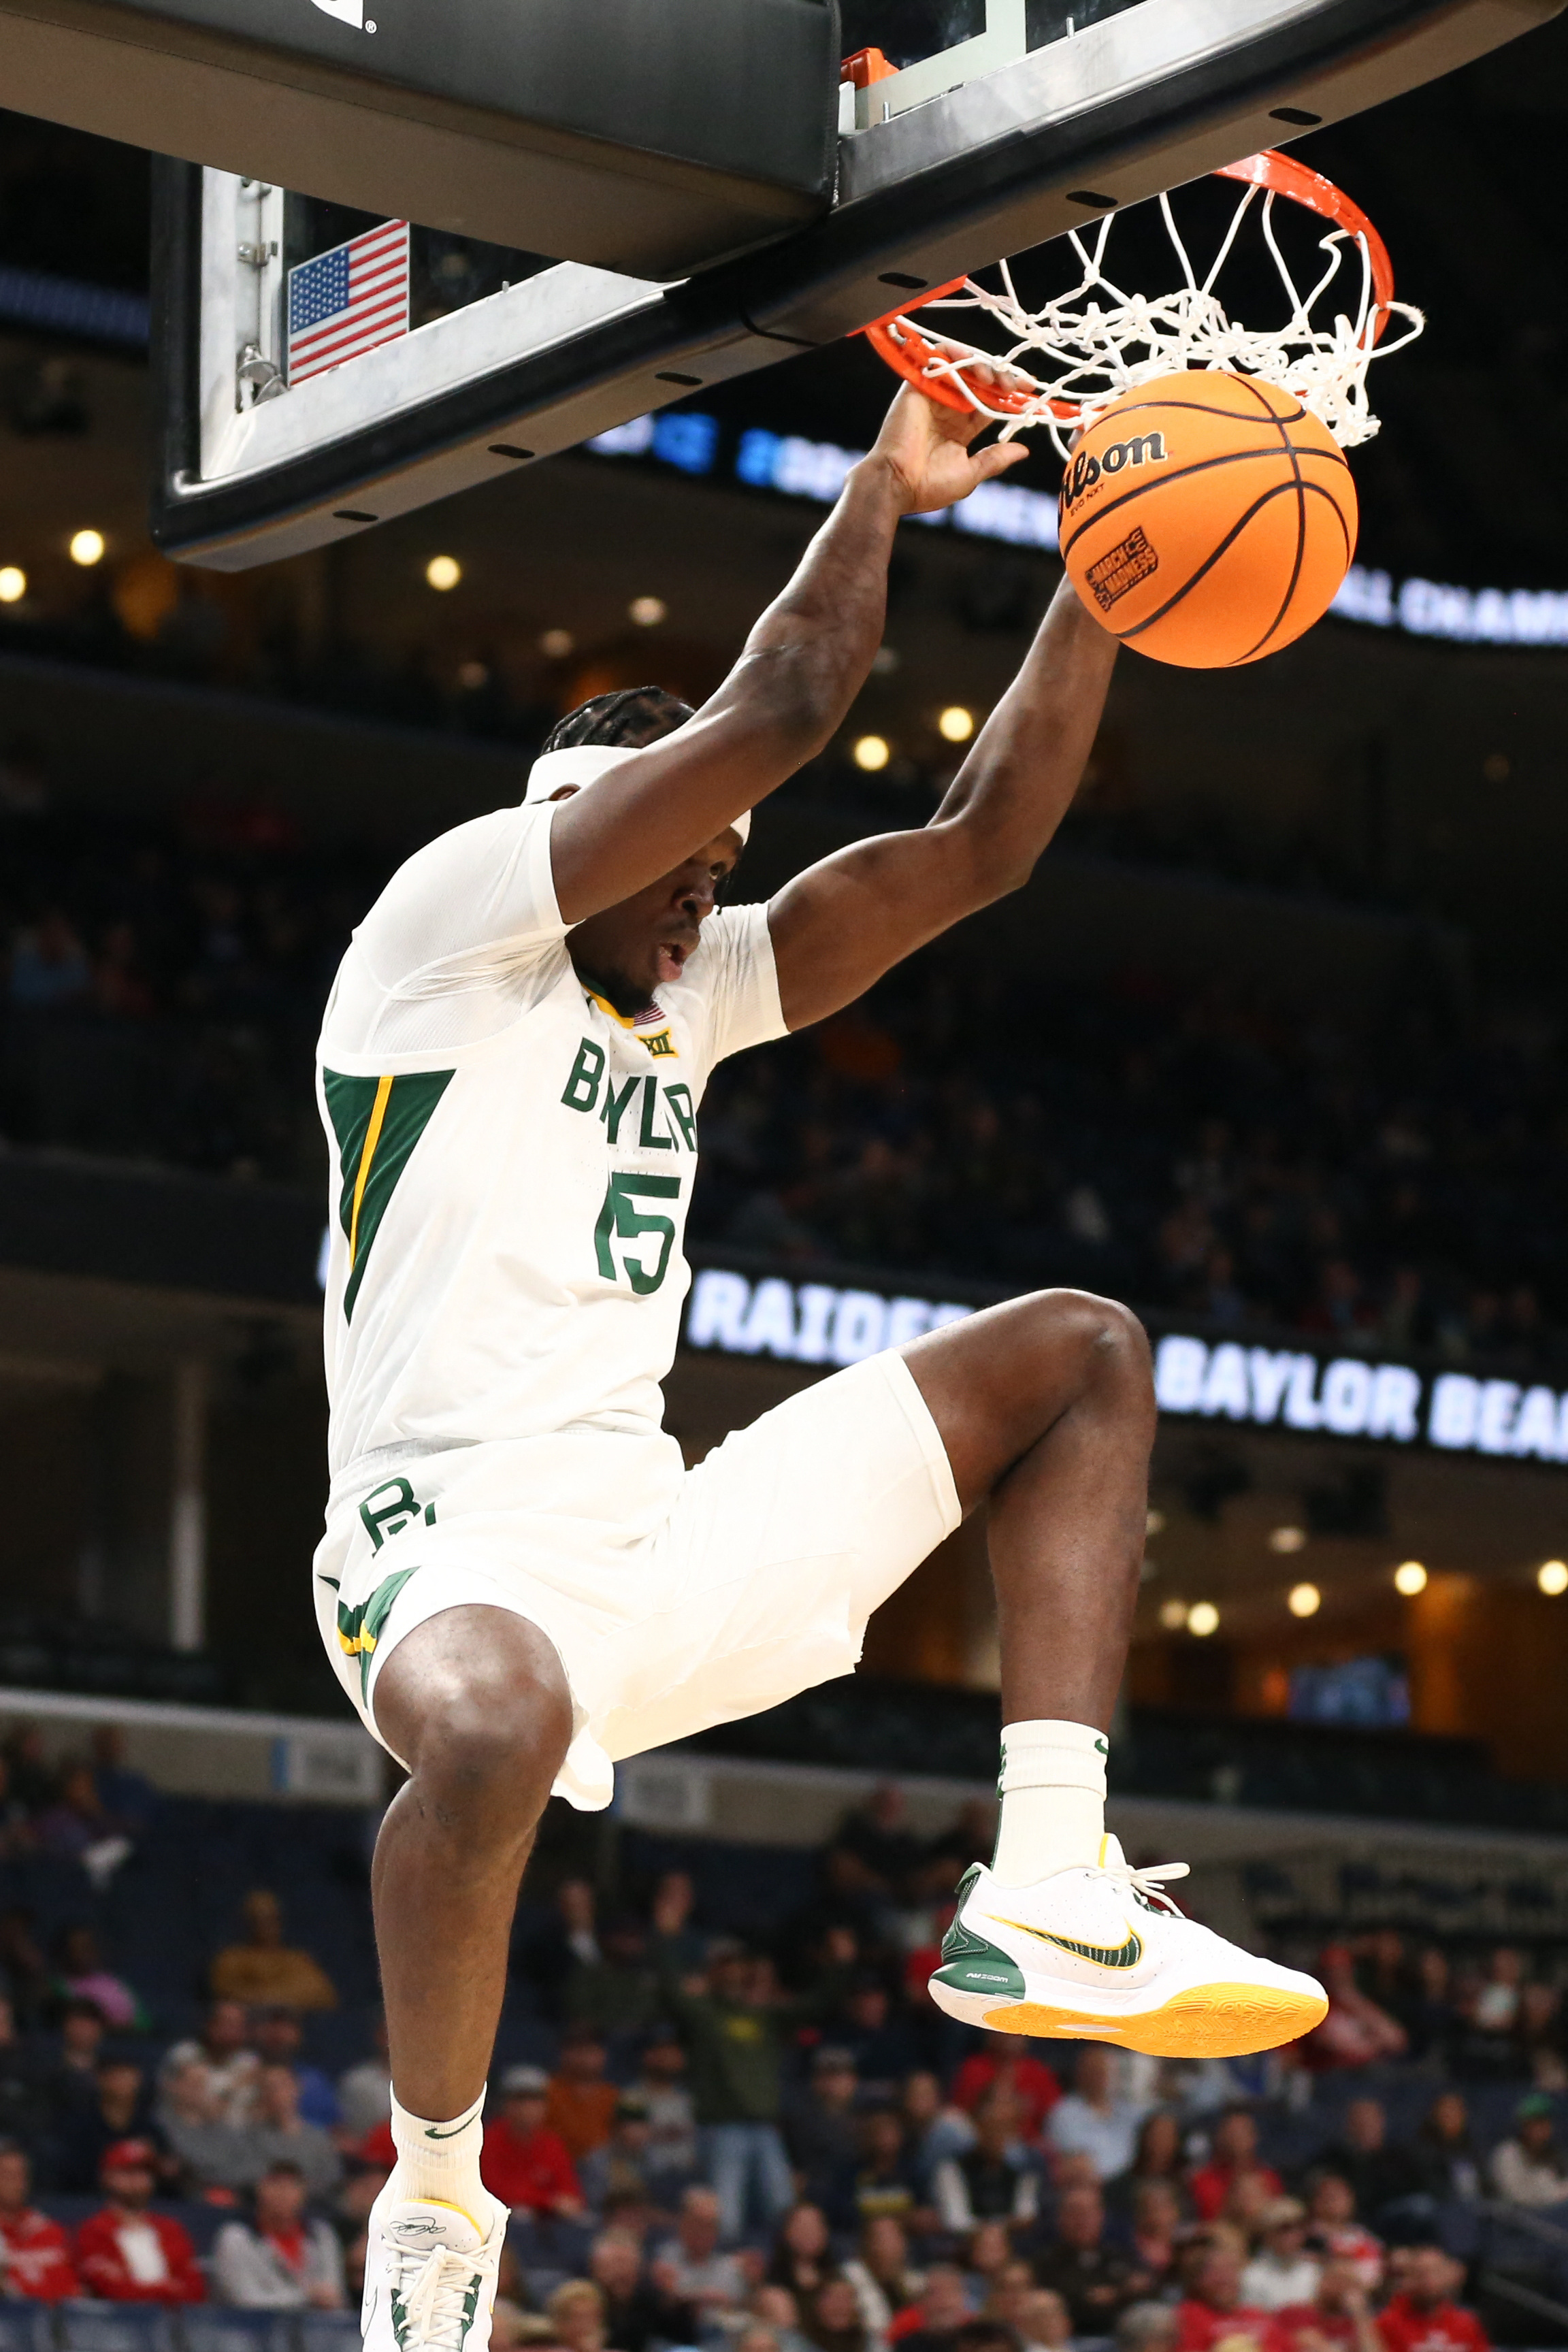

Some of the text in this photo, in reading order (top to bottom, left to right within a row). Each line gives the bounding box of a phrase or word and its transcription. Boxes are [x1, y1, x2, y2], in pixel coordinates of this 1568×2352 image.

[1090, 544, 1129, 585] MARCH
[1103, 545, 1158, 595] MADNESS
[593, 1171, 681, 1295] 15
[1156, 1335, 1422, 1443] BAYLOR
[1429, 1371, 1568, 1463] BEA
